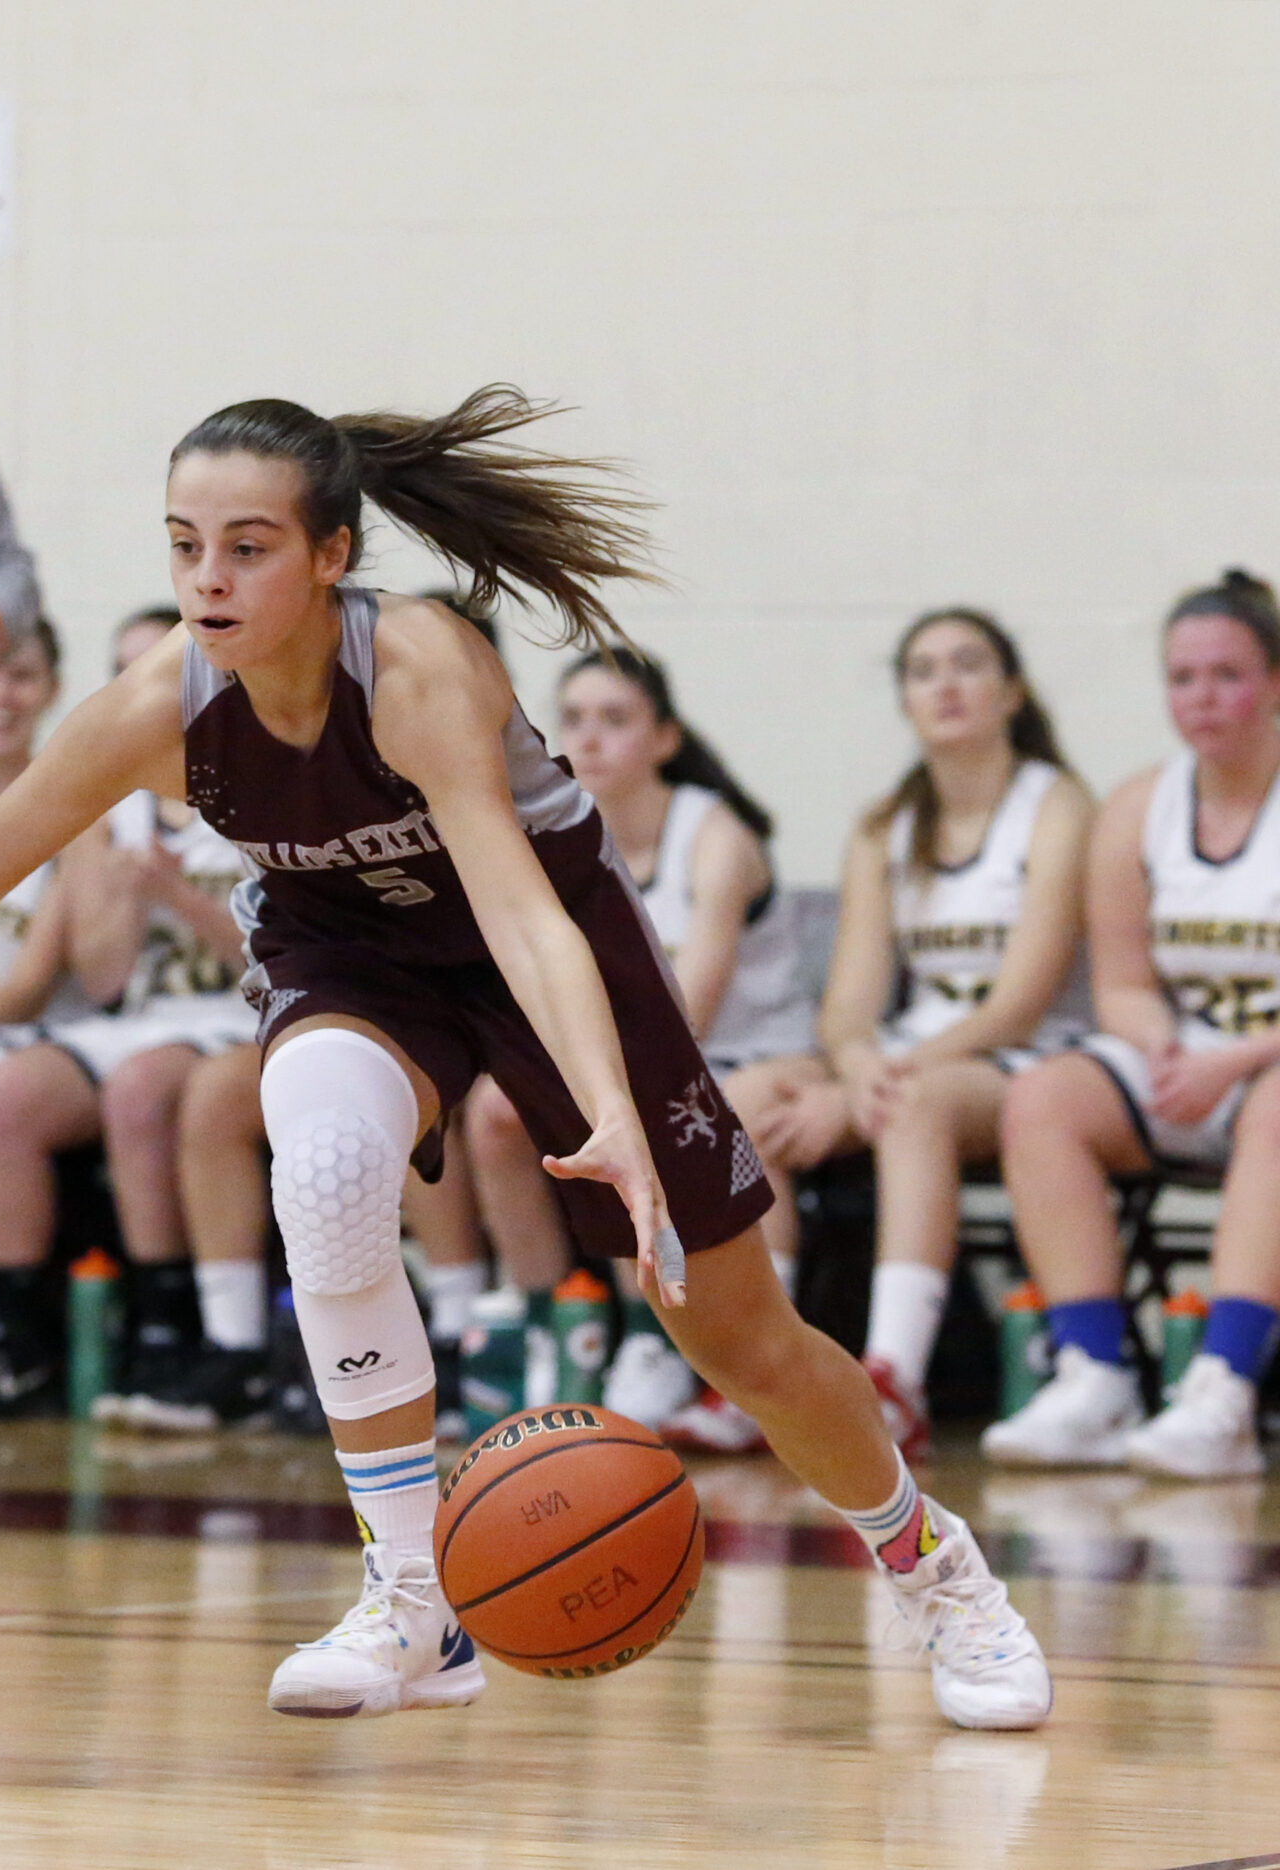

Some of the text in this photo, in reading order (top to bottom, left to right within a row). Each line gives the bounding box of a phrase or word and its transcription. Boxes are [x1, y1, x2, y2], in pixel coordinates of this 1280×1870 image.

[356, 866, 437, 907] 5
[441, 1408, 605, 1503] Wilson
[519, 1489, 572, 1527] VAR
[558, 1564, 640, 1624] PEA
